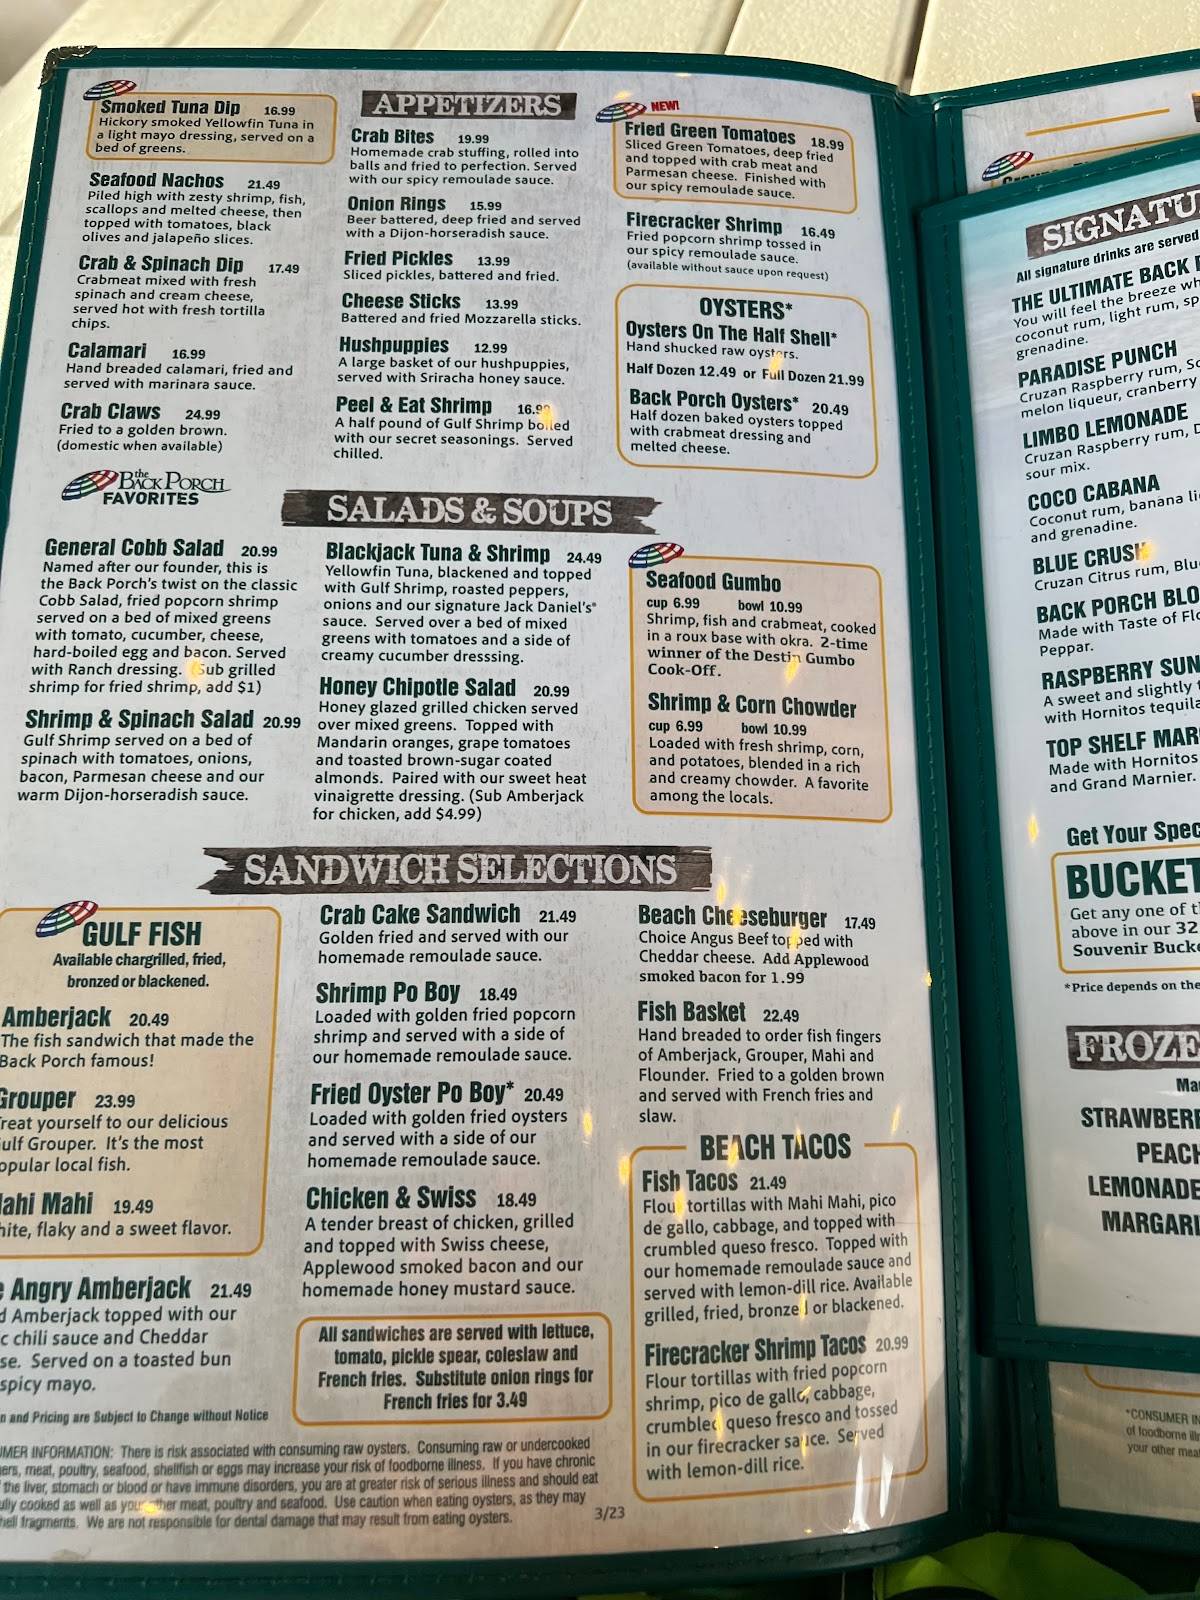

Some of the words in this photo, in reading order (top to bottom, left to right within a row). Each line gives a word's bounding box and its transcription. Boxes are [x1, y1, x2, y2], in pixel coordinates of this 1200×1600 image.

[101, 100, 166, 113] Smoked
[171, 100, 208, 114] Tuna
[214, 101, 240, 116] Dip
[264, 106, 295, 116] 16.99
[372, 94, 561, 116] APPETIZERS
[651, 100, 680, 111] NEW!
[352, 128, 388, 143] Crab
[395, 129, 434, 144] Bites
[458, 135, 489, 144] 19.99
[625, 122, 664, 136] Fried
[671, 123, 717, 139] Green
[722, 125, 796, 144] Tomatoes
[811, 138, 844, 151] 18.99
[90, 172, 156, 186] Seafood
[162, 173, 224, 188] Nachos
[248, 180, 280, 190] 21.49
[348, 196, 394, 211] Onion
[400, 196, 446, 212] Rings
[470, 202, 502, 210] 15.99
[627, 212, 720, 230] Firecracker
[726, 216, 782, 236] Shrimp
[802, 226, 835, 239] 16.49
[82, 232, 120, 242] olives
[125, 232, 148, 242] and
[152, 233, 210, 245] jalapeño
[214, 234, 252, 244] slices.
[79, 255, 118, 270] Crab
[124, 255, 136, 270] &
[142, 256, 210, 272] Spinach
[216, 257, 243, 274] Dip
[269, 264, 299, 273] 17.49
[345, 250, 386, 266] Fried
[392, 251, 452, 266] Pickles
[478, 257, 510, 266] 13.99
[628, 260, 678, 270] (available
[682, 264, 721, 272] without
[758, 269, 782, 277] upon
[787, 272, 828, 281] request)
[342, 293, 403, 308] Cheese
[410, 294, 460, 308] Sticks
[486, 300, 518, 309] 13.99
[72, 318, 109, 330] chips.
[626, 320, 687, 339] Oysters
[693, 324, 713, 339] On
[718, 325, 747, 341] The
[754, 327, 784, 343] Half
[68, 342, 146, 358] Calamari
[173, 350, 205, 359] 16.99
[340, 336, 449, 354] Hushpuppies
[475, 344, 507, 353] 12.99
[1016, 336, 1089, 361] grenadine.
[1018, 354, 1104, 389] PARADISE
[1112, 340, 1177, 368] PUNCH
[61, 403, 102, 419] Crab
[108, 403, 160, 419] Claws
[186, 410, 220, 420] 24.99
[629, 388, 672, 407] Back
[677, 390, 725, 408] Porch
[812, 403, 848, 416] 20.49
[1023, 423, 1078, 450] LIMBO
[1086, 403, 1188, 438] LEMONADE
[58, 440, 119, 452] (domestic
[124, 440, 156, 450] when
[162, 441, 222, 453] available)
[134, 469, 149, 478] the
[1026, 468, 1055, 480] sour
[1061, 462, 1090, 474] mix.
[103, 491, 200, 505] FAVORITES
[1028, 488, 1076, 511] COCO
[1083, 474, 1160, 502] CABANA
[327, 495, 464, 523] SALADS
[471, 497, 497, 525] &
[503, 499, 613, 527] SOUPS
[1031, 529, 1056, 543] and
[1061, 519, 1138, 541] grenadine.
[46, 538, 116, 556] General
[122, 538, 167, 556] Cobb
[173, 539, 224, 556] Salad
[241, 546, 277, 557] 20.99
[326, 542, 415, 562] Blackjack
[420, 544, 462, 561] Tuna
[468, 544, 481, 561] &
[487, 544, 550, 565] Shrimp
[567, 552, 601, 564] 24.49
[646, 570, 716, 590] Seafood
[722, 573, 781, 592] Gumbo
[646, 599, 668, 610] cup
[674, 598, 700, 608] 6.99
[738, 600, 764, 611] bowl
[770, 601, 802, 613] 10.99
[1039, 641, 1095, 658] Peppar.
[320, 677, 377, 698] Honey
[383, 677, 458, 698] Chipotle
[465, 678, 516, 696] Salad
[534, 686, 569, 697] 20.99
[1051, 779, 1076, 792] and
[1082, 775, 1126, 790] Grand
[1133, 770, 1196, 787] Marnier.
[244, 854, 450, 885] SANDWICH
[457, 854, 678, 885] SELECTIONS
[321, 905, 365, 925] Crab
[372, 904, 420, 924] Cake
[427, 903, 520, 924] Sandwich
[540, 910, 576, 922] 21.49
[82, 921, 142, 946] GULF
[149, 921, 202, 946] FISH
[68, 975, 119, 988] bronzed
[122, 978, 136, 987] or
[138, 974, 209, 987] blackened.
[316, 982, 386, 1005] Shrimp
[394, 982, 418, 1002] Po
[425, 981, 460, 1004] Boy
[480, 988, 517, 1001] 18.49
[2, 1006, 111, 1030] Amberjack
[130, 1014, 169, 1026] 20.49
[638, 1000, 676, 1021] Fish
[684, 1001, 746, 1022] Basket
[764, 1010, 799, 1022] 22.49
[643, 1170, 680, 1192] Fish
[686, 1170, 738, 1192] Tacos
[750, 1176, 786, 1190] 21.49
[307, 1187, 388, 1210] Chicken
[396, 1186, 410, 1208] &
[417, 1186, 476, 1208] Swiss
[498, 1192, 536, 1207] 18.49
[384, 1393, 432, 1410] French
[436, 1393, 468, 1409] fries
[472, 1392, 492, 1408] for
[496, 1391, 527, 1408] 3.49
[22, 1515, 79, 1530] fragments.
[87, 1515, 104, 1528] We
[108, 1517, 124, 1528] are
[128, 1515, 144, 1528] not
[149, 1513, 212, 1531] responsible
[215, 1513, 230, 1527] for
[234, 1512, 267, 1527] dental
[271, 1512, 314, 1531] damage
[318, 1512, 340, 1527] that
[342, 1514, 365, 1530] may
[369, 1511, 400, 1526] result
[403, 1511, 429, 1525] from
[432, 1511, 465, 1528] eating
[468, 1511, 513, 1528] oysters.
[594, 1507, 626, 1521] 3/23
